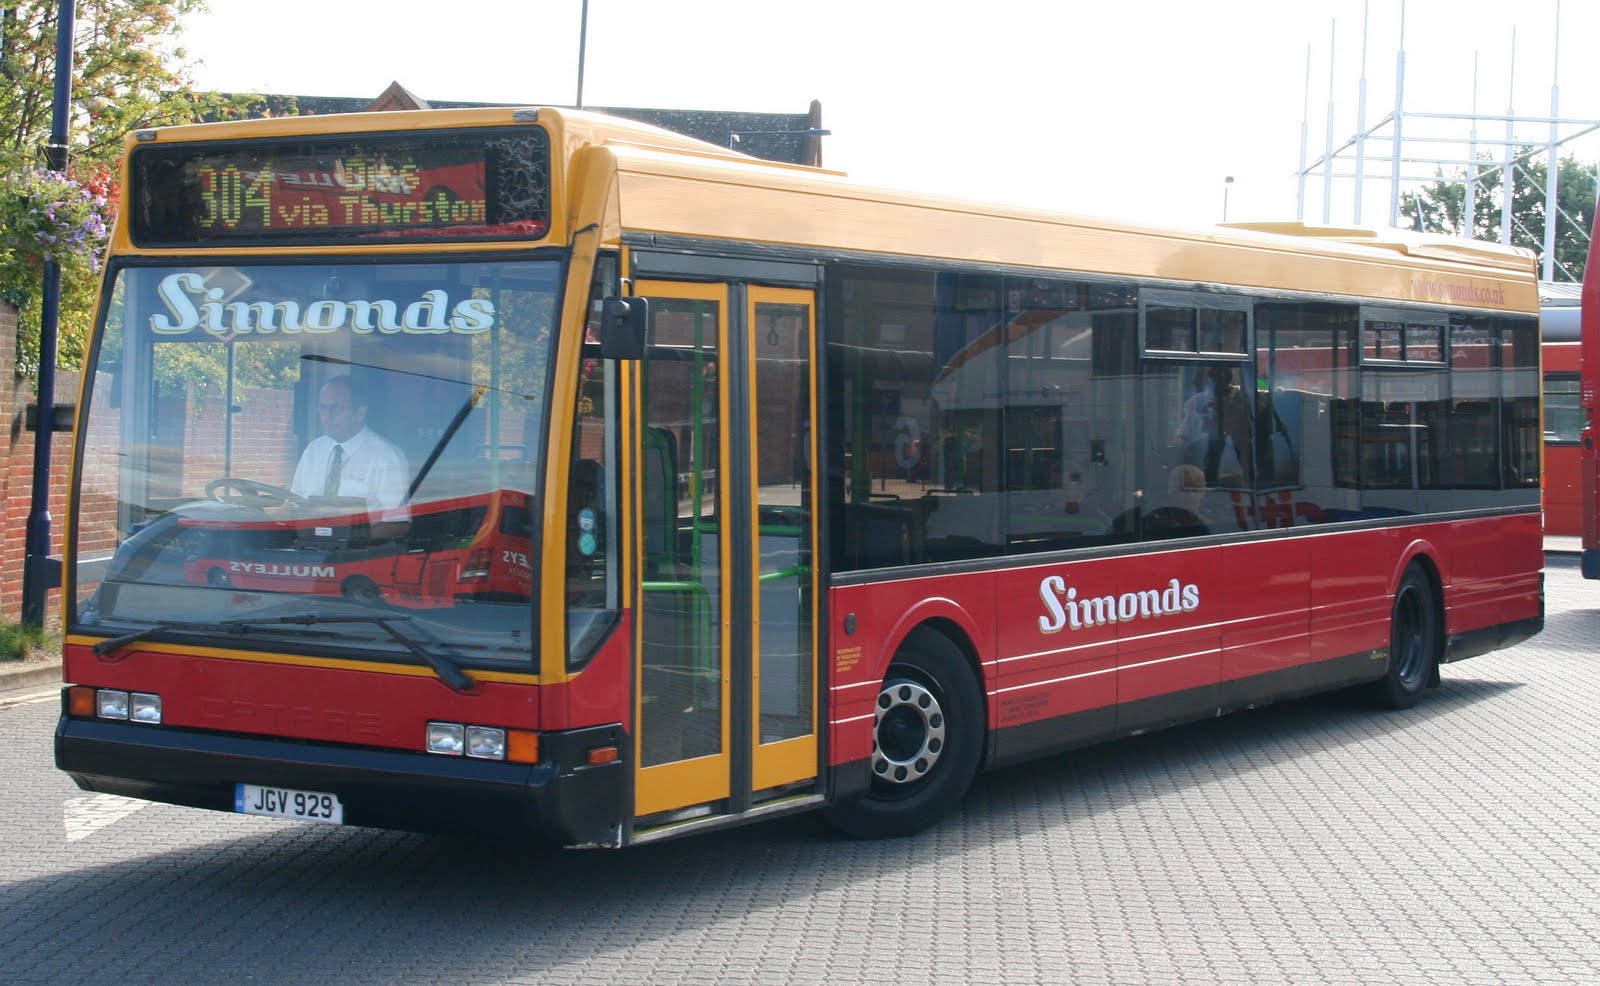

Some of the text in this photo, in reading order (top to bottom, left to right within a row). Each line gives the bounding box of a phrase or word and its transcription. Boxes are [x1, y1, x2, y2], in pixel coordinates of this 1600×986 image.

[196, 163, 271, 228] 304
[278, 192, 486, 226] via Thurston
[149, 272, 496, 335] Simonds
[1038, 574, 1200, 633] Simonds
[254, 788, 333, 819] JGV 929
